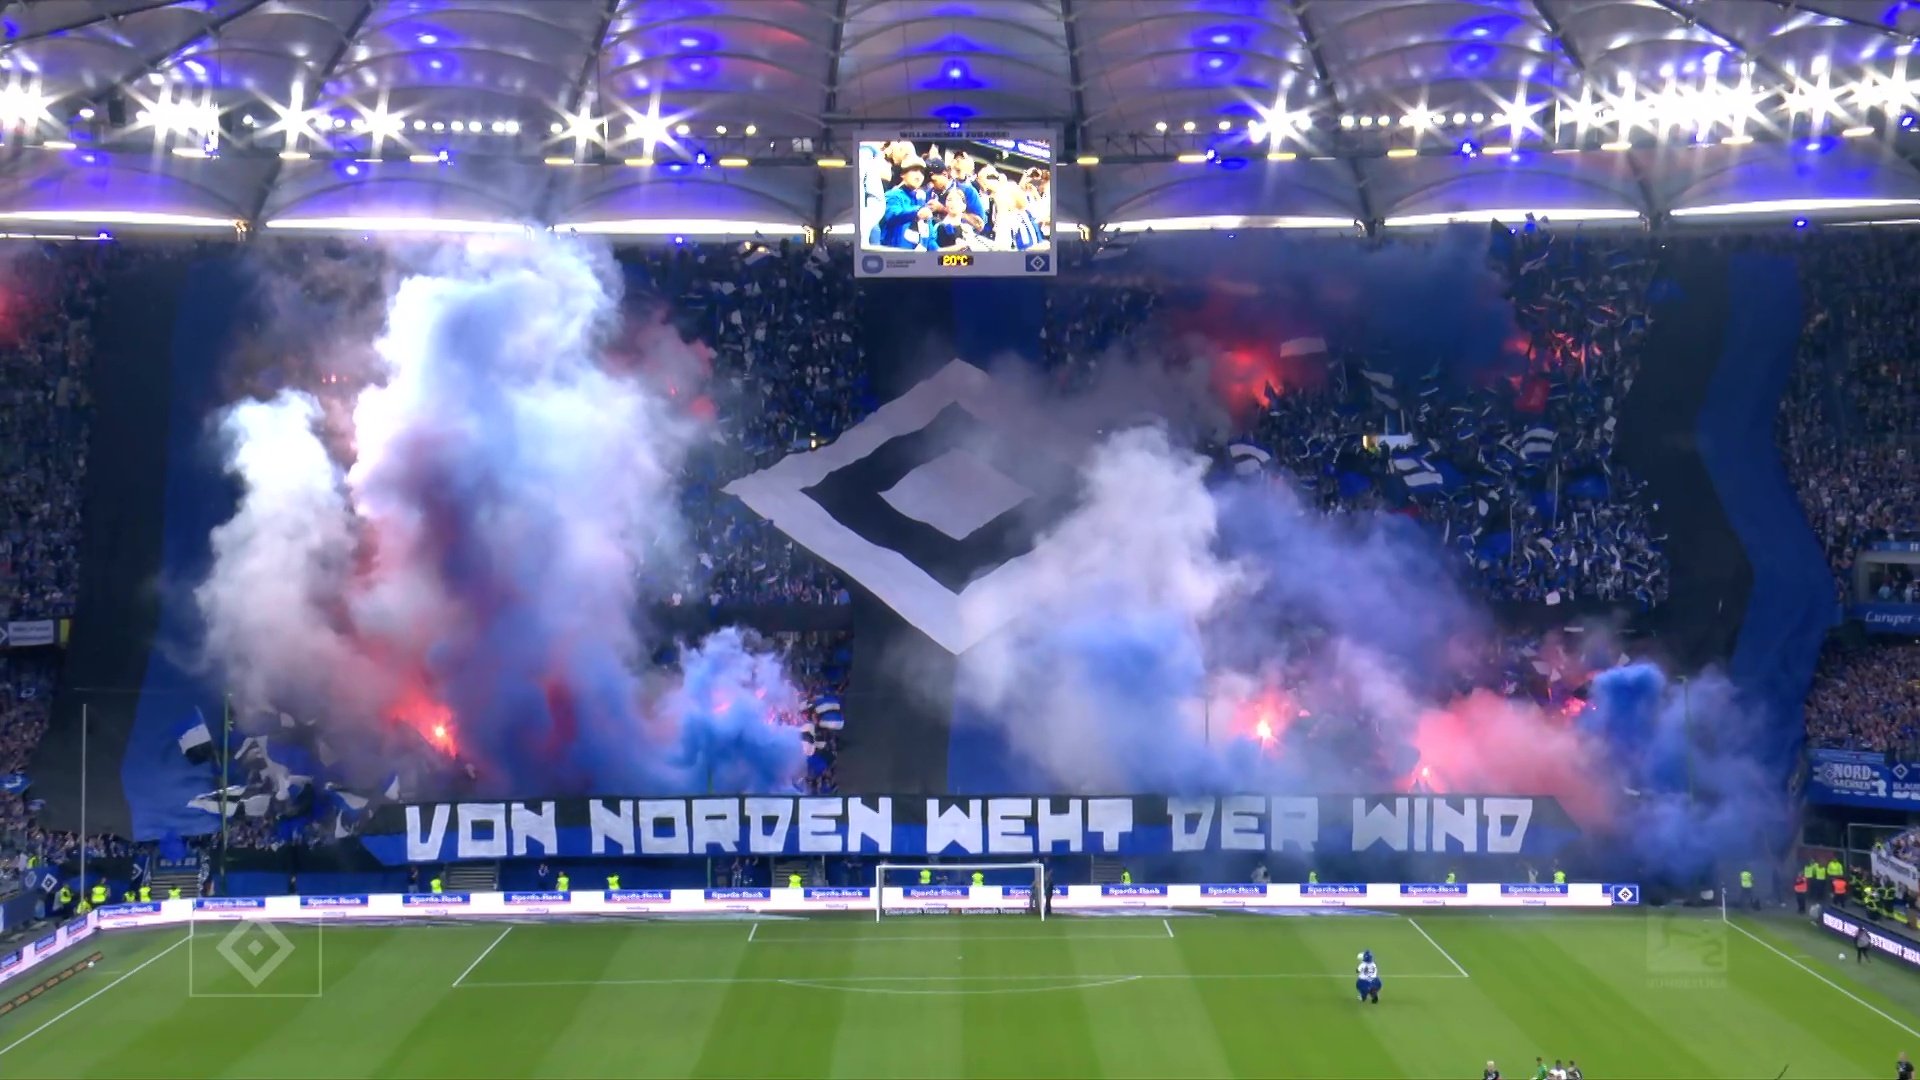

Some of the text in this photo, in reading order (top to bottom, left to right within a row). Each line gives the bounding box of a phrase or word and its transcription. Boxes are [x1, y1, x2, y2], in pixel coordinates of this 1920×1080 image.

[406, 797, 1533, 861] VON NORDEN WEHT DER WIND
